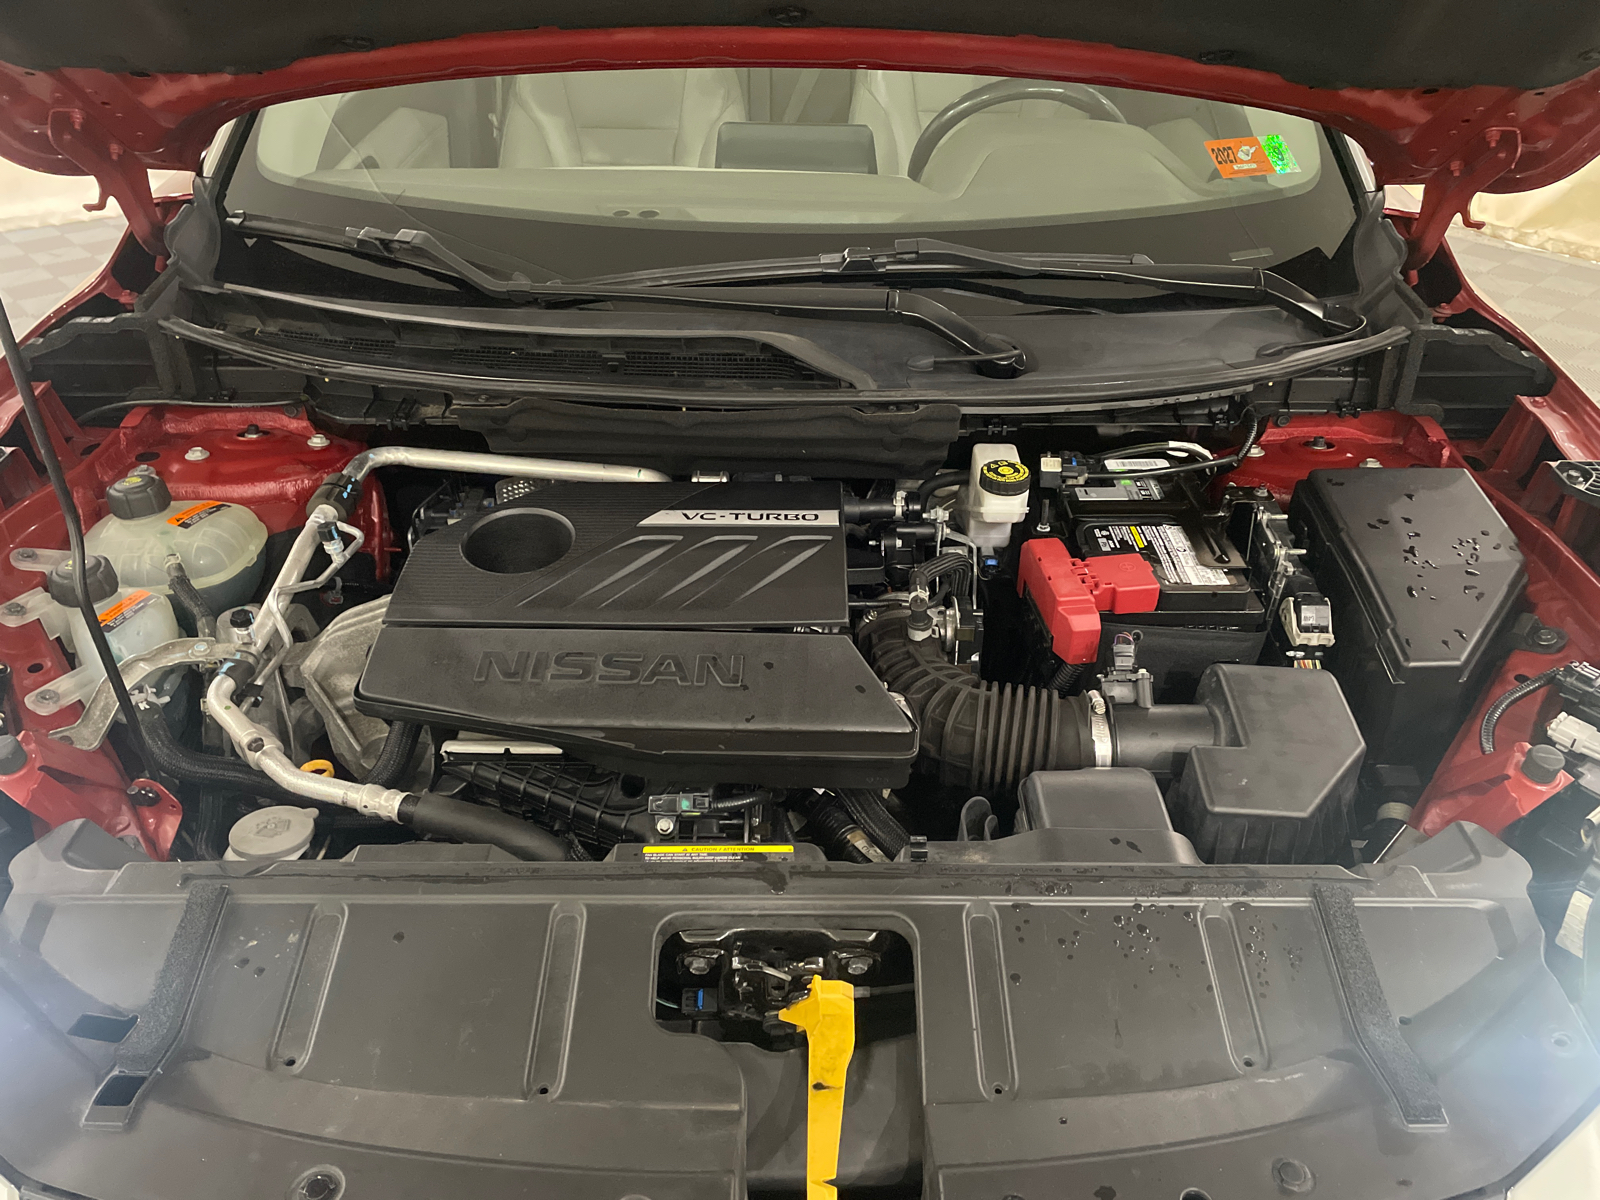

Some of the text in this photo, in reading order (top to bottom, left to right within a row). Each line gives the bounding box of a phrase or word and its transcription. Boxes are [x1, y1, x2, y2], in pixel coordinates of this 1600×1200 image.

[1211, 146, 1238, 165] 2027
[681, 512, 819, 521] VC-TURBO
[473, 651, 745, 687] NISSAN
